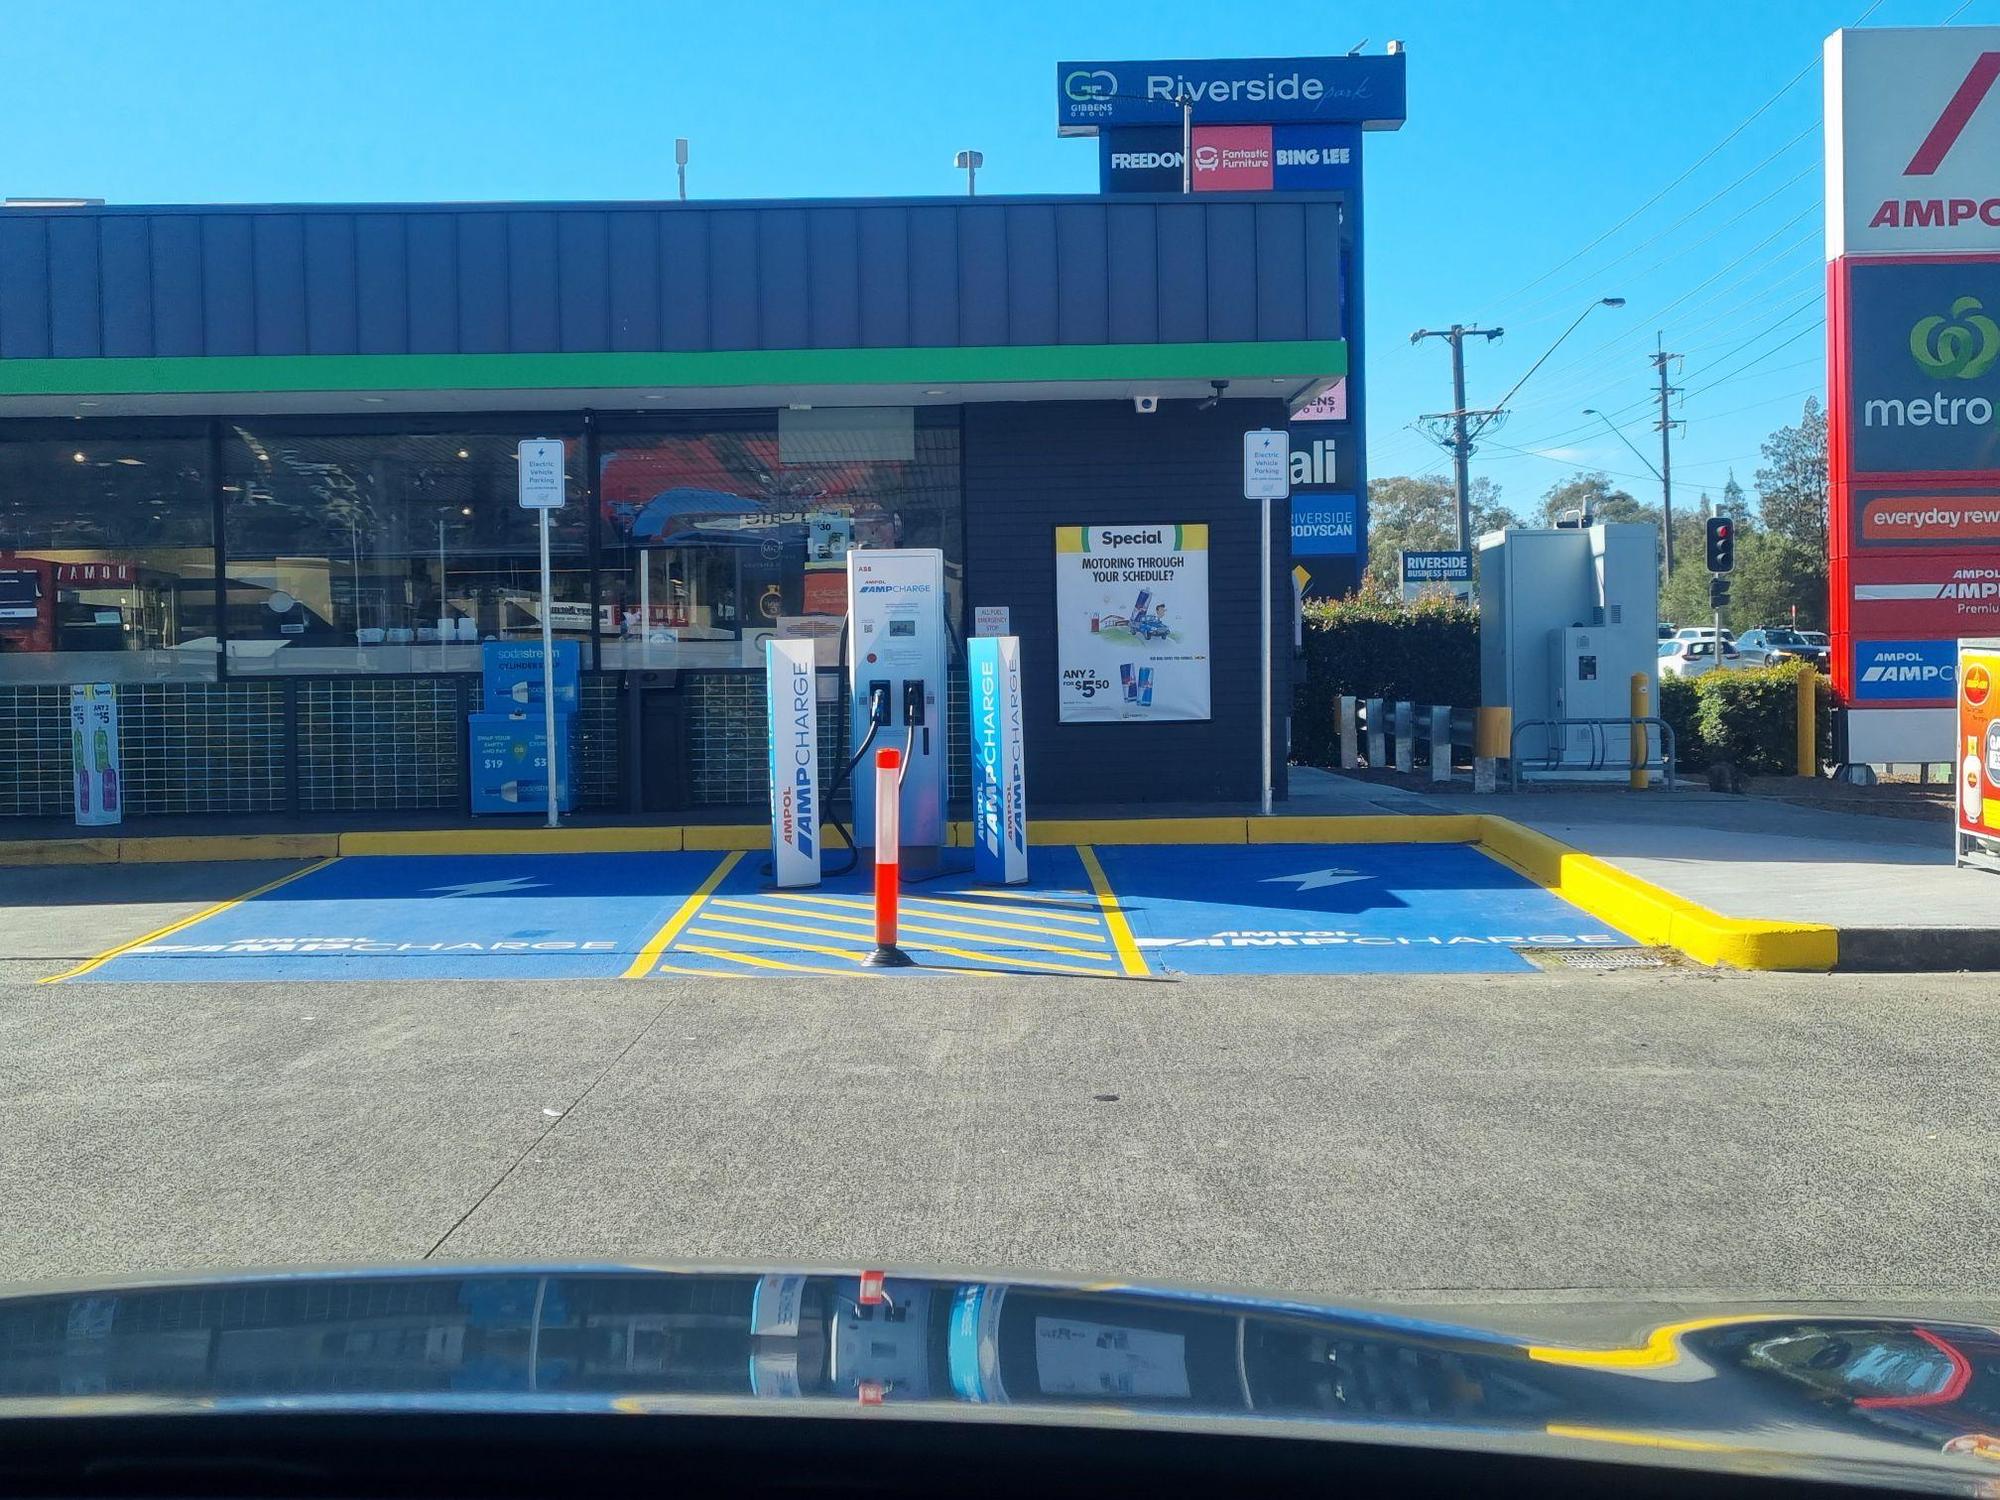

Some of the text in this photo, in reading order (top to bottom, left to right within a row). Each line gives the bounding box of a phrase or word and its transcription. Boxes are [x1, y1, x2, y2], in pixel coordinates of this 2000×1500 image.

[1147, 73, 1374, 112] Riverside park
[1070, 104, 1113, 112] GIBBENS
[1222, 148, 1269, 159] Fantastic
[1276, 148, 1350, 165] BING LEE
[1222, 159, 1269, 168] Furniture
[1865, 393, 1992, 427] metro
[1874, 508, 1961, 528] everyday
[1102, 531, 1162, 548] Special
[1082, 557, 1184, 569] MOTORING THROUGH
[1407, 557, 1467, 569] RIVERSIDE
[1093, 570, 1174, 582] YOUR SCHEDULE?
[866, 585, 931, 593] AMPCHARGE
[1940, 584, 2000, 598] AMP
[1958, 603, 2000, 613] Premiu
[498, 648, 560, 659] sodastrem
[1874, 653, 1924, 661] AMPOL
[1063, 669, 1095, 679] ANY 2
[793, 662, 812, 836] AMPCHARGE
[982, 661, 998, 836] AMPCHARGE
[1009, 659, 1024, 835] AMPCHARGE
[484, 759, 503, 769] $19
[783, 786, 792, 845] AMPOL
[977, 782, 985, 841] AMPOL
[170, 941, 618, 952] AMPCHARGE
[1174, 934, 1617, 947] AMPCHARGE
